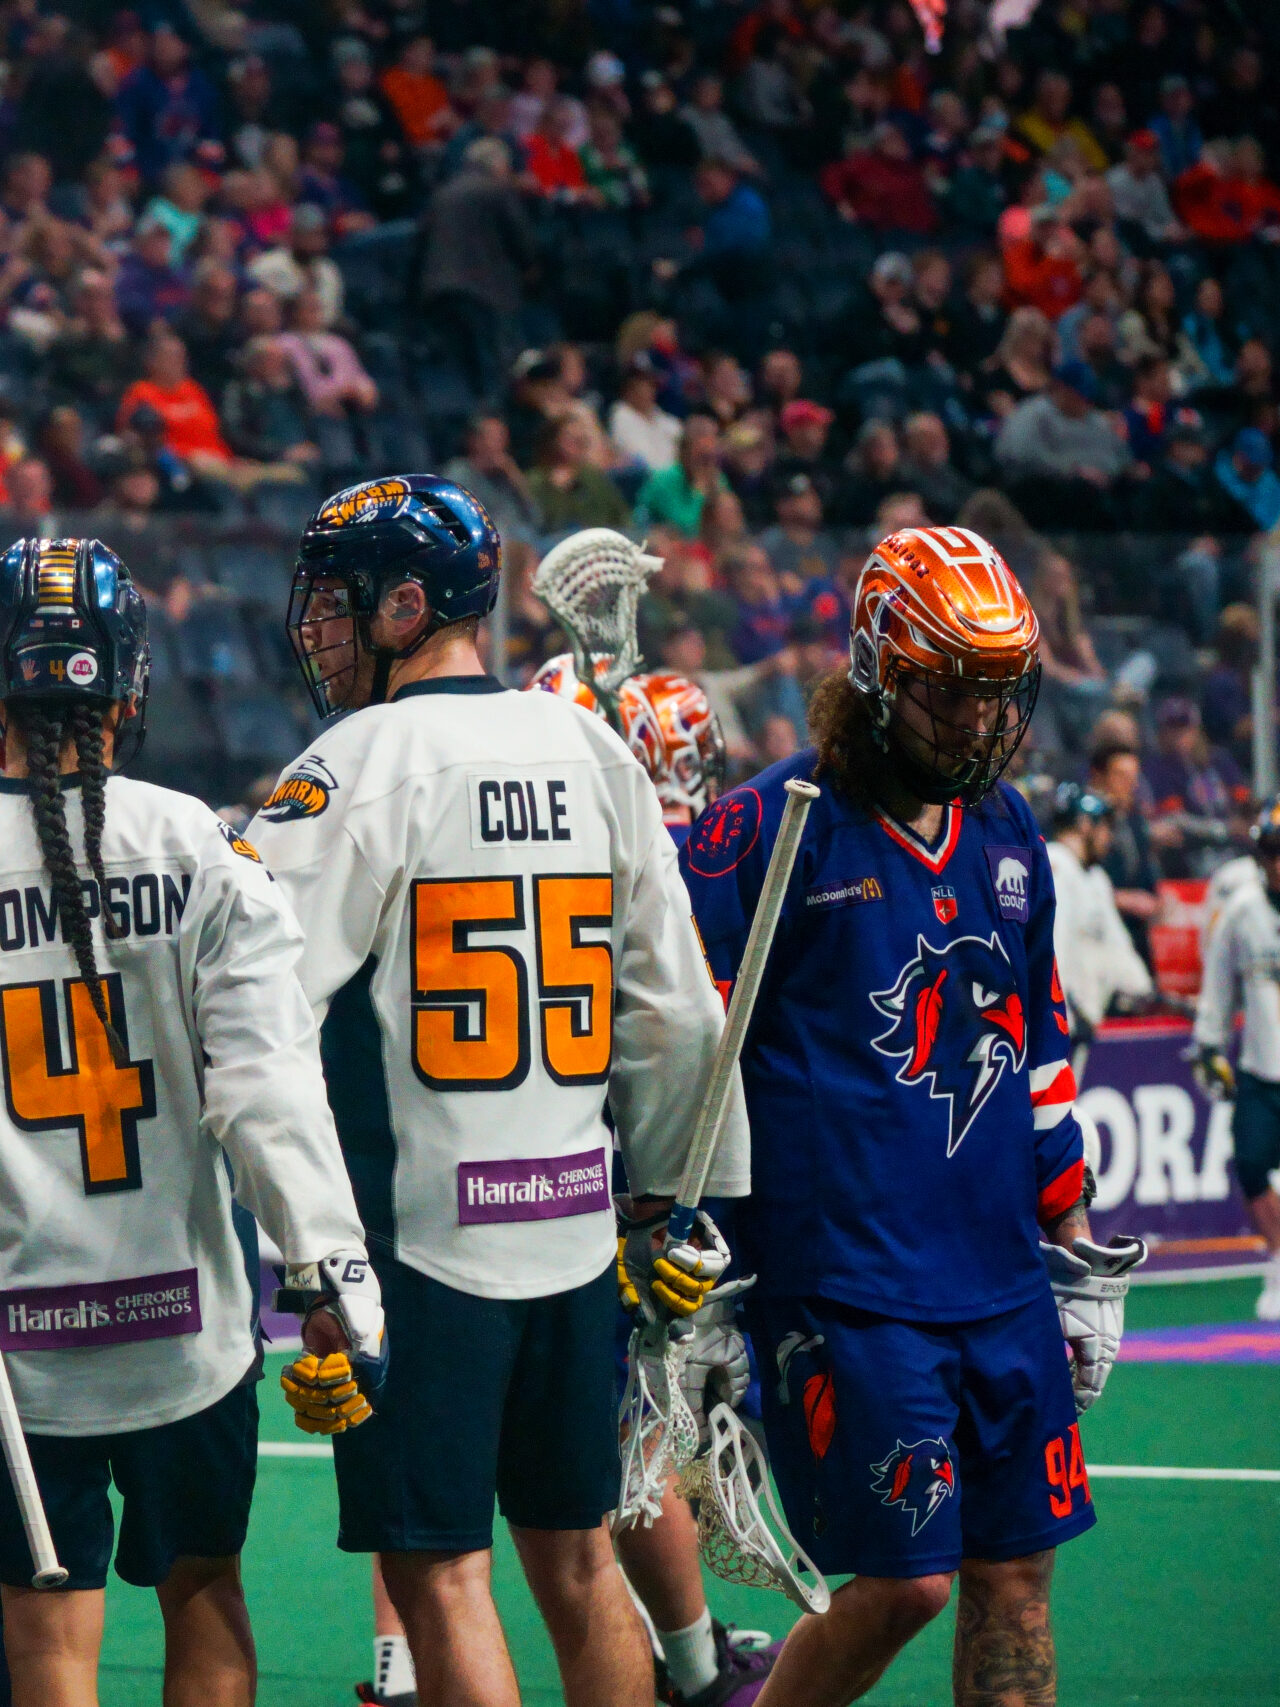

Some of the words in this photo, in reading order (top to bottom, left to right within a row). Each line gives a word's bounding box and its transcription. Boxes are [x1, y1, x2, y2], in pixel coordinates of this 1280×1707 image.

[49, 660, 66, 682] 4
[479, 780, 571, 842] COLE
[806, 885, 862, 906] McDonald's
[933, 888, 954, 898] NLL
[410, 873, 613, 1092] 55
[558, 1163, 603, 1185] CHEROKEE
[467, 1174, 555, 1206] Harrah's
[557, 1178, 605, 1198] CASINOS
[115, 1285, 191, 1310] CHEROKEE
[8, 1300, 109, 1333] Harrah's
[116, 1301, 192, 1324] CASINOS
[1045, 1422, 1092, 1519] 94
